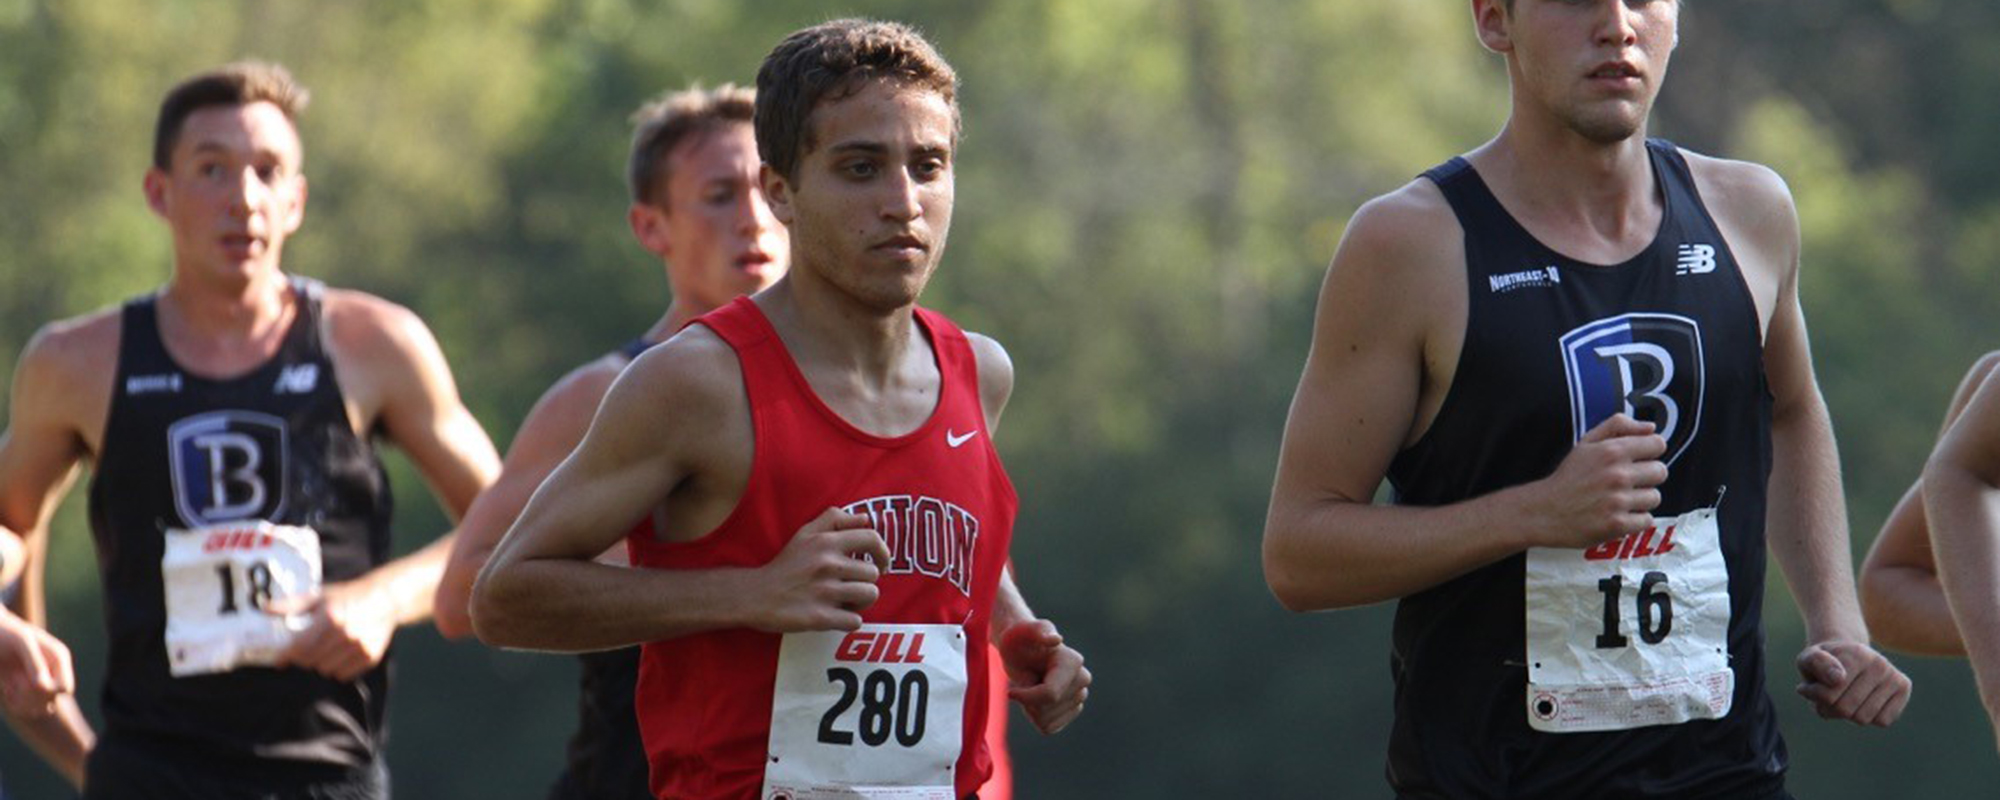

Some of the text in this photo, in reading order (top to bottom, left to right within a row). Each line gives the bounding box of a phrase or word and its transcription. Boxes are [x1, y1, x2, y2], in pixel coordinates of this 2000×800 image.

[1594, 342, 1679, 443] B
[195, 432, 266, 521] B
[840, 494, 979, 597] NION
[214, 561, 272, 615] 18
[1595, 571, 1674, 648] 16
[835, 632, 925, 664] GILL
[817, 667, 930, 748] 280
